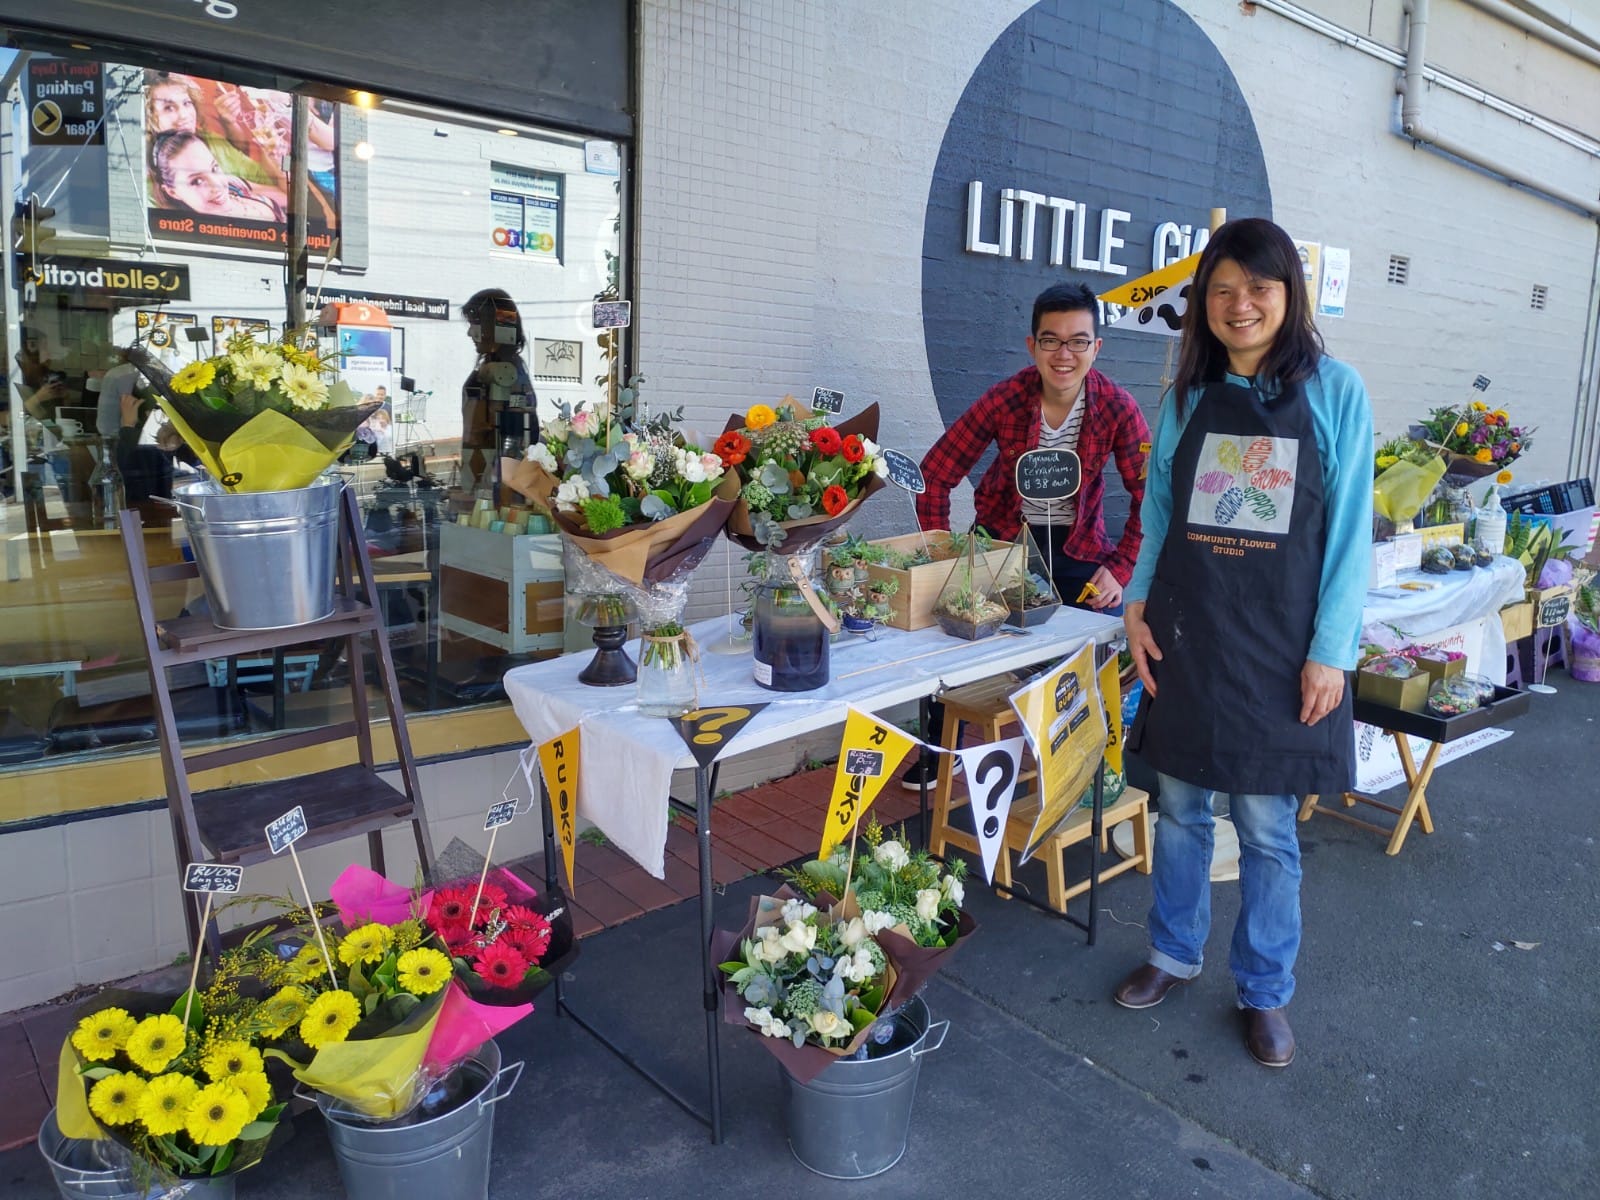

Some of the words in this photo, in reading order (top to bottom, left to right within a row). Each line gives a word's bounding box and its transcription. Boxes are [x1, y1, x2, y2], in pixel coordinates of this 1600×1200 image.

[1035, 478, 1050, 489] 38
[1250, 467, 1294, 490] GROWTH
[1243, 486, 1277, 522] SUPPORT
[1186, 531, 1238, 546] COMMUNITY
[1240, 537, 1277, 550] FLOWER
[1212, 545, 1246, 557] STUDIO
[973, 748, 1015, 840] ?
